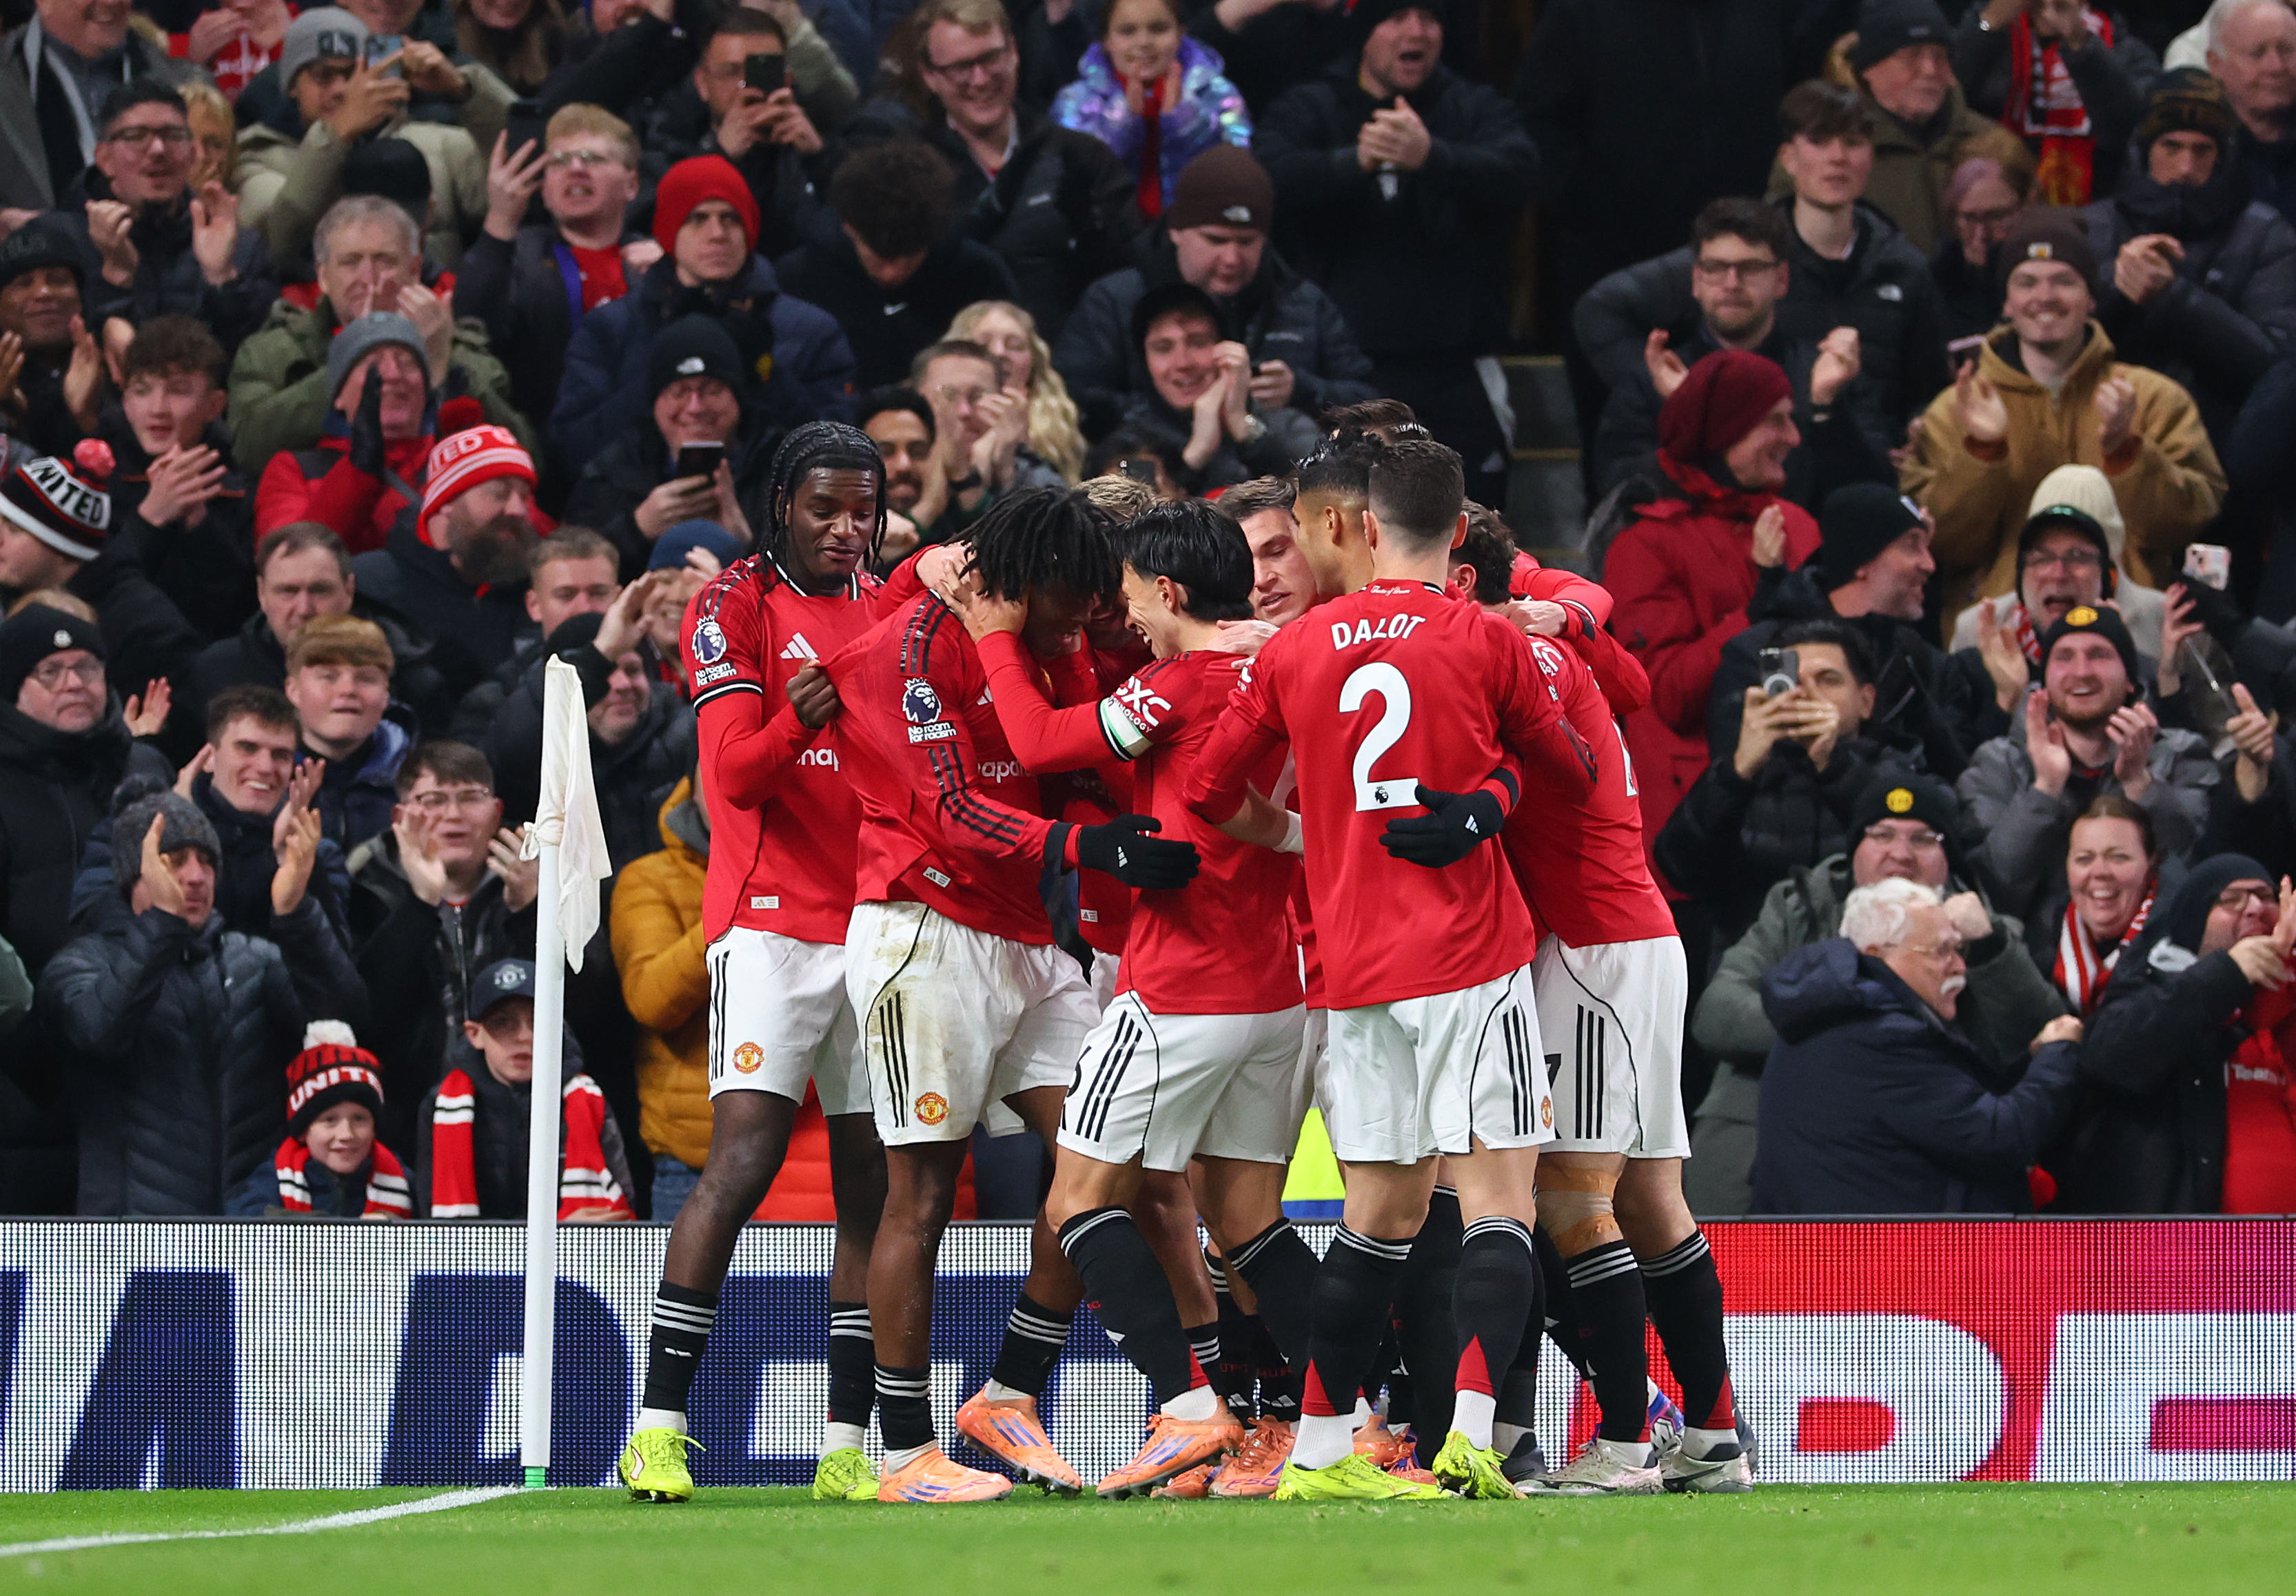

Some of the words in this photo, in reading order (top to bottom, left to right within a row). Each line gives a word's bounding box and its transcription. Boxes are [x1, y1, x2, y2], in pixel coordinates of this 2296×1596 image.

[32, 466, 103, 522] NITED
[1331, 613, 1426, 650] DALOT
[695, 669, 706, 679] No
[704, 662, 731, 675] room
[696, 678, 708, 687] for
[707, 668, 737, 682] racism
[908, 726, 924, 736] No
[924, 722, 951, 733] room
[909, 733, 924, 744] for
[924, 728, 957, 741] racism
[1339, 662, 1420, 812] 2
